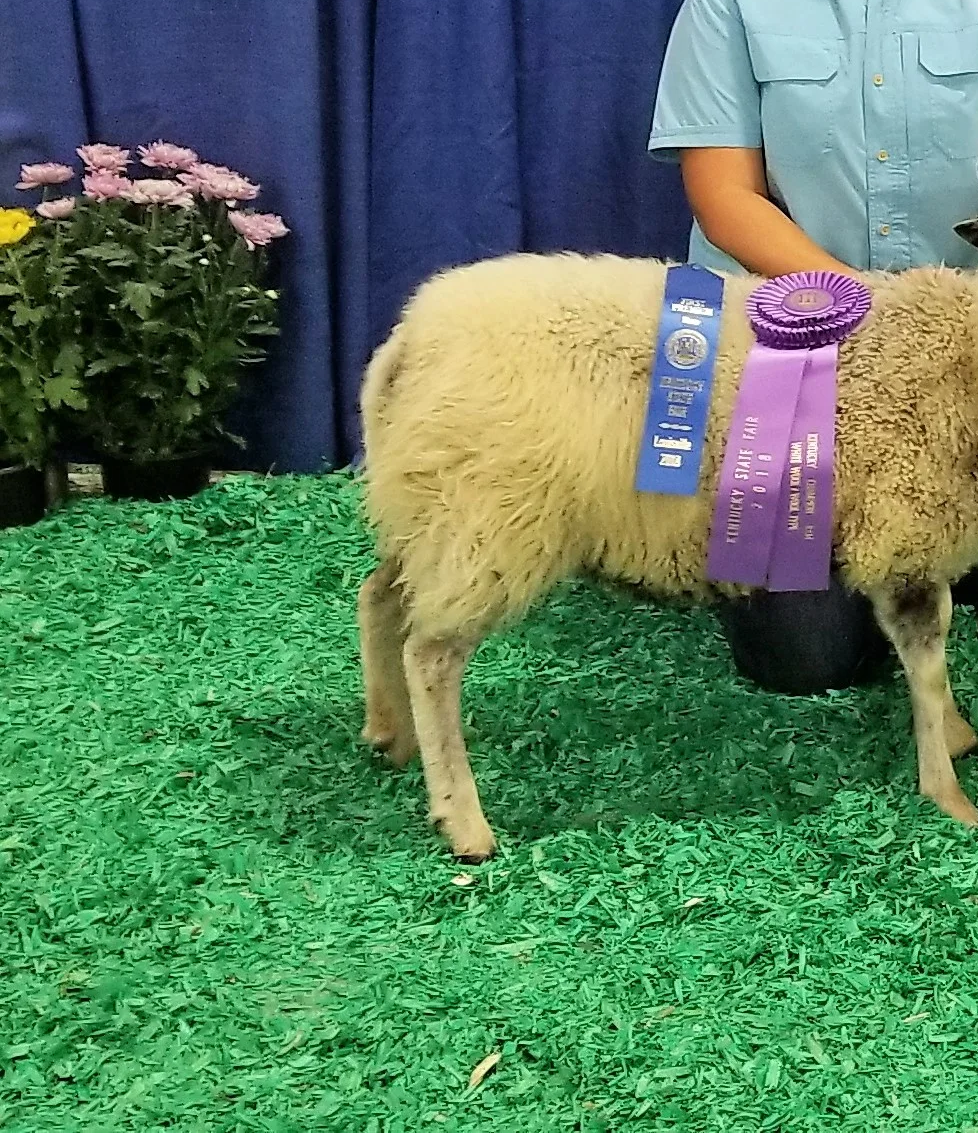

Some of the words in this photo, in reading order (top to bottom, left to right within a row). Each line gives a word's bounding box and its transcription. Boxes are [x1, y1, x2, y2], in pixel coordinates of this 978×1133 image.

[743, 415, 760, 446] FAIR
[734, 449, 753, 482] STATE
[805, 433, 819, 469] KENTUCKY
[726, 488, 745, 544] KENTUCKY
